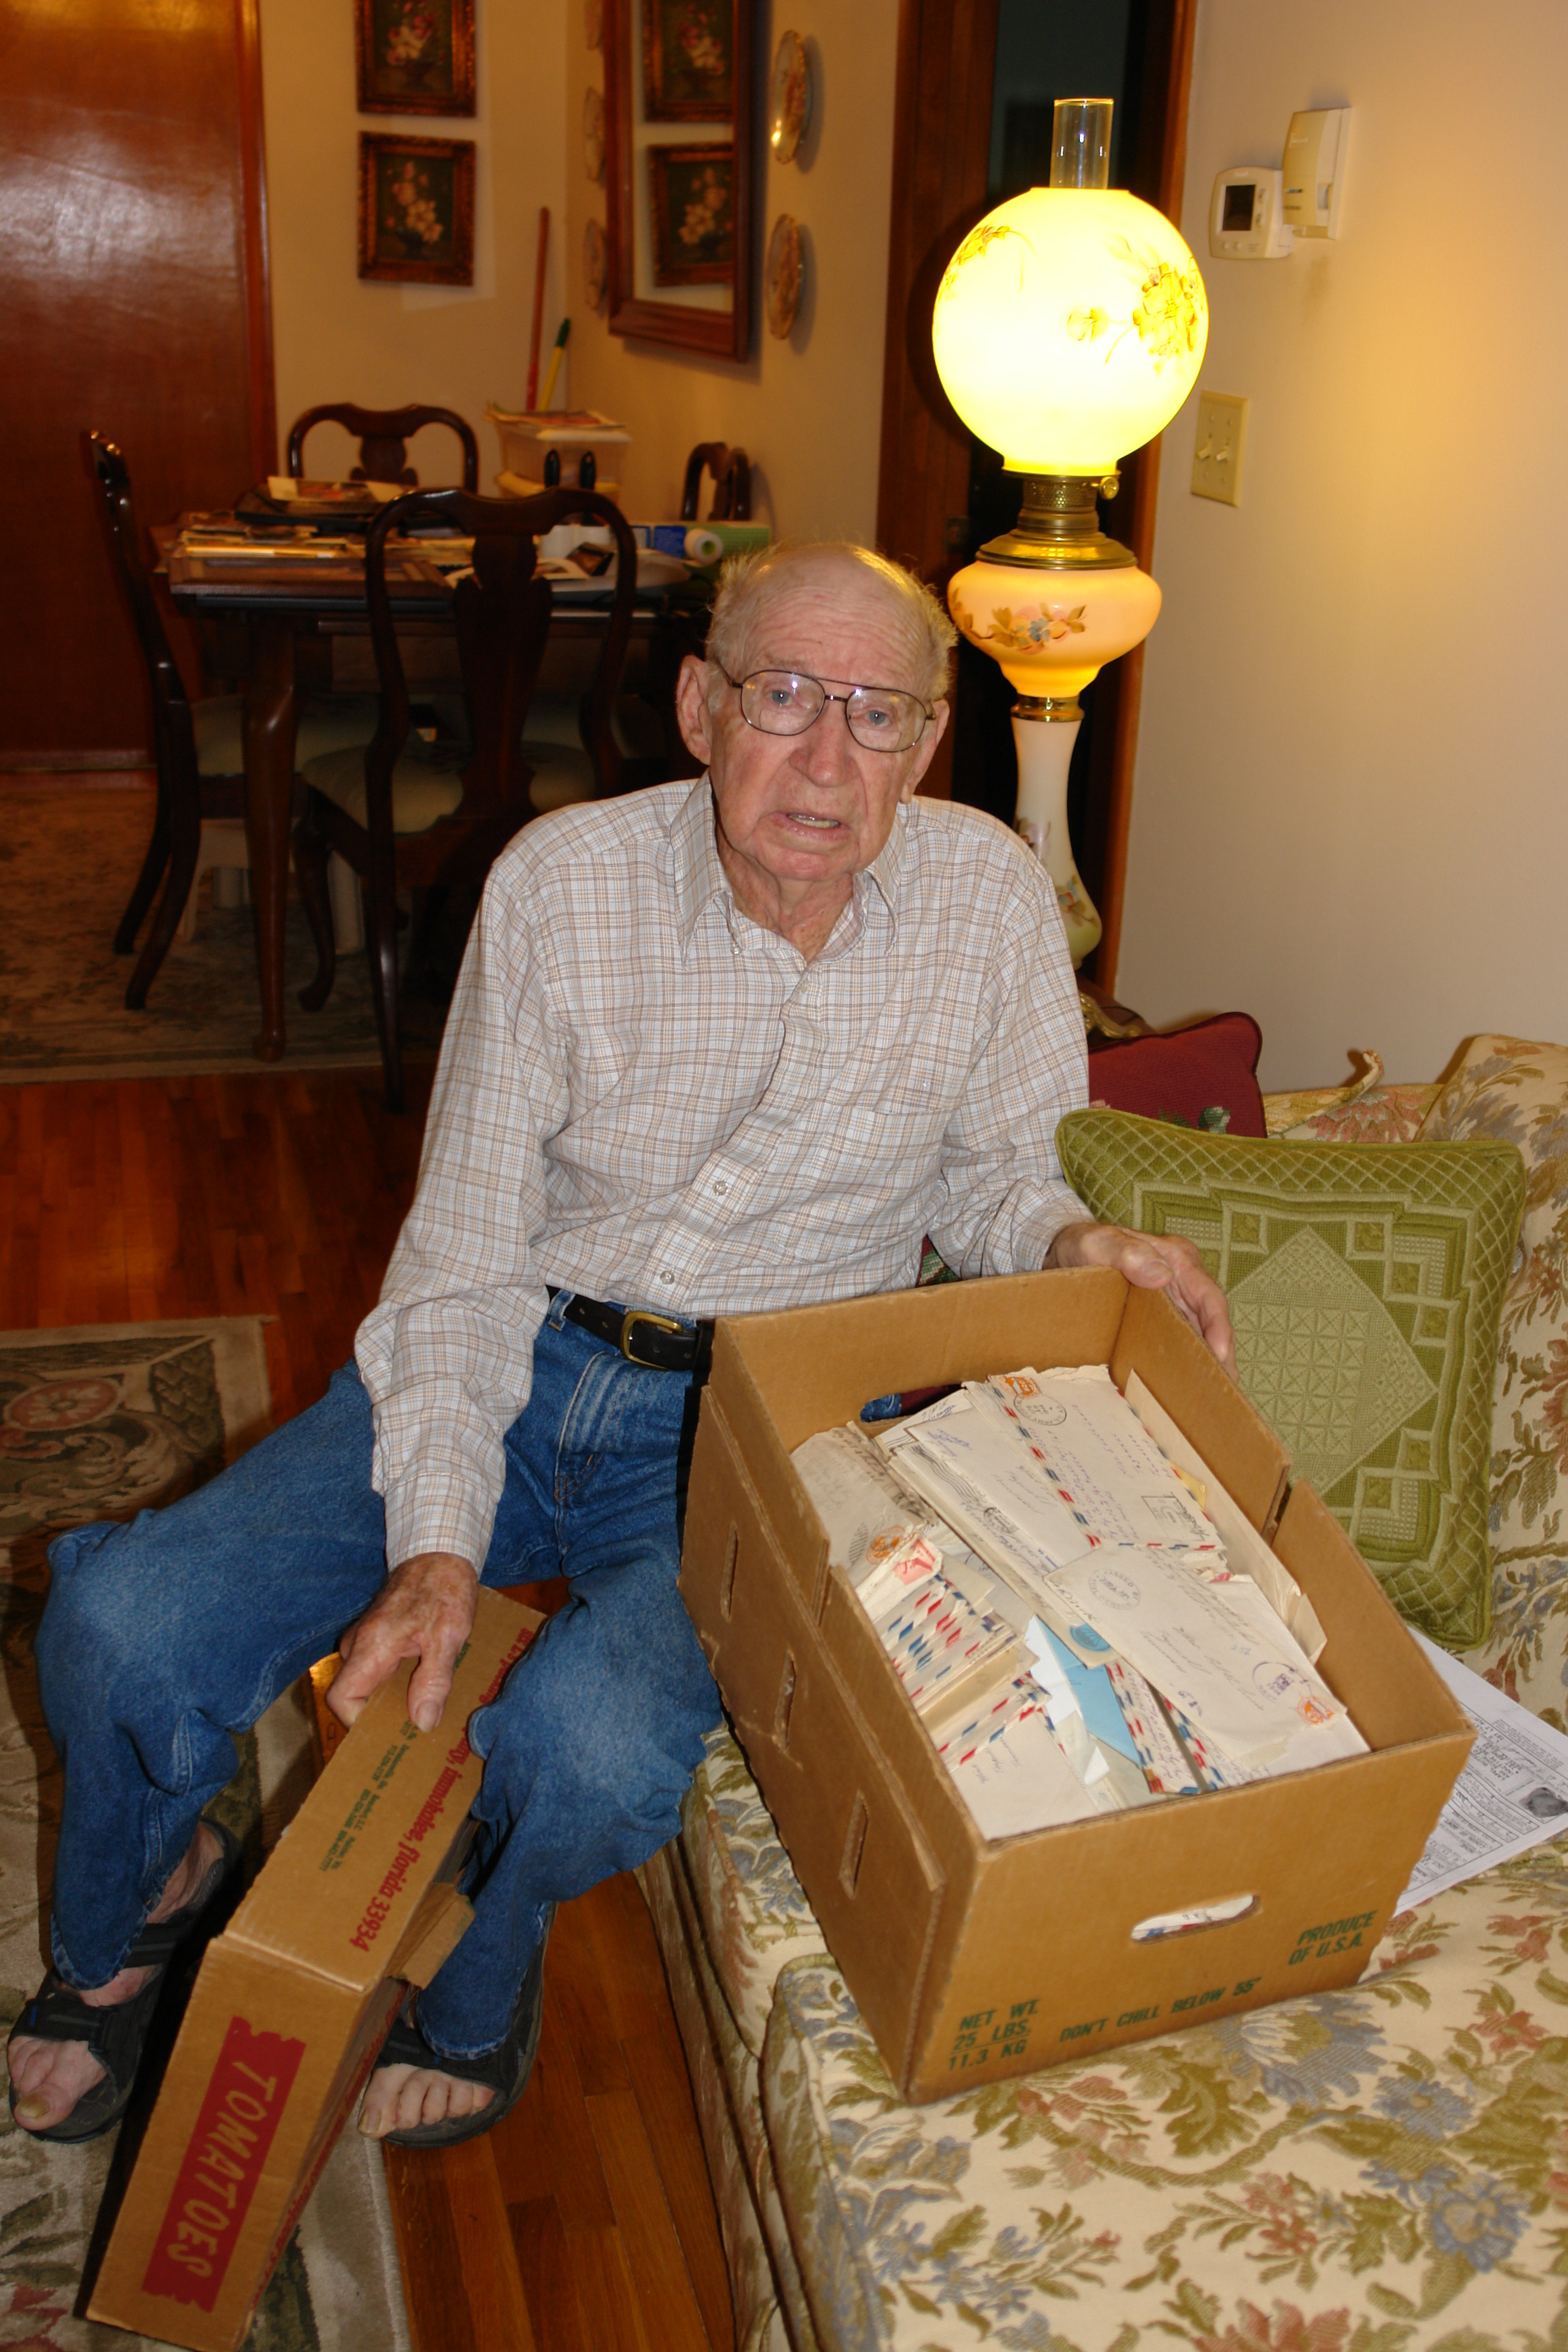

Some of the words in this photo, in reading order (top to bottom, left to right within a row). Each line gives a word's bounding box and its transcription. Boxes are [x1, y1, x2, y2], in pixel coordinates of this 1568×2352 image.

[378, 1842, 420, 1898] florida
[350, 1897, 390, 1952] 33934
[1297, 1910, 1379, 1946] PRODUCE
[1288, 1946, 1315, 1966] OF
[959, 2009, 998, 2032] NET
[1059, 2017, 1108, 2043] DON'T
[1116, 2005, 1160, 2028] CHILL
[1171, 1987, 1226, 2014] BELOW
[949, 2049, 988, 2072] 11.3
[1000, 2039, 1027, 2059] KG
[952, 2032, 977, 2051] 25
[167, 2061, 278, 2278] TOMATOES
